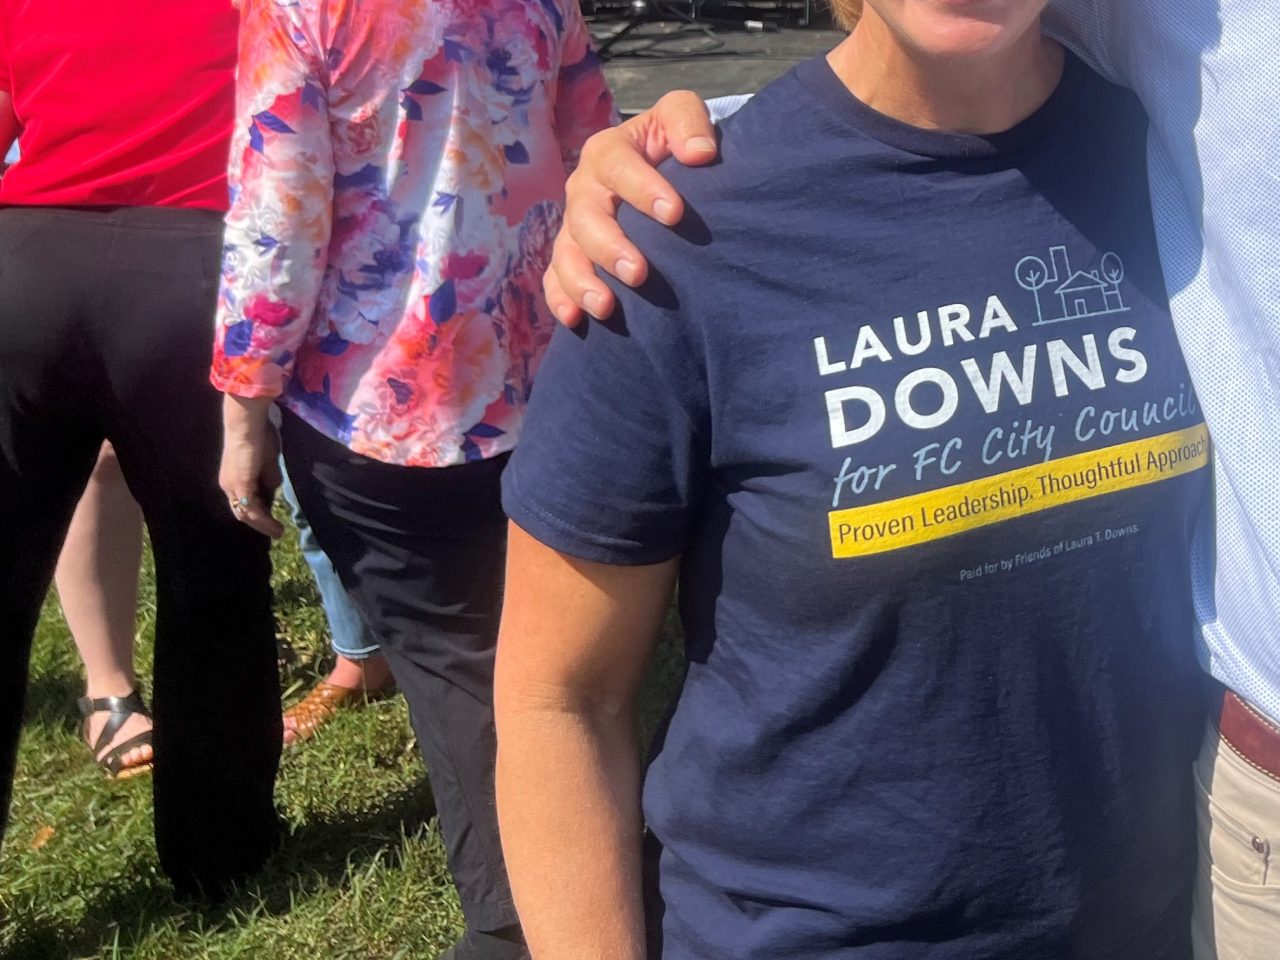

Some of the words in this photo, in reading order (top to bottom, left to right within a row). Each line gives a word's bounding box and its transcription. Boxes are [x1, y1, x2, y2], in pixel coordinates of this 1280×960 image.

[813, 294, 1018, 376] LAURA
[824, 326, 1148, 448] DOWNS
[831, 456, 897, 508] for
[913, 436, 963, 481] FC
[981, 419, 1055, 463] City
[1074, 382, 1197, 442] Council
[838, 511, 914, 545] Proven
[921, 483, 1034, 528] Leadership.
[1036, 451, 1141, 497] Thoughtful
[1147, 435, 1208, 472] Approach
[960, 563, 983, 581] Paid
[984, 561, 1000, 574] for
[1000, 556, 1014, 572] by
[1015, 547, 1051, 566] Friends
[1053, 542, 1065, 554] of
[1065, 534, 1094, 552] Laura
